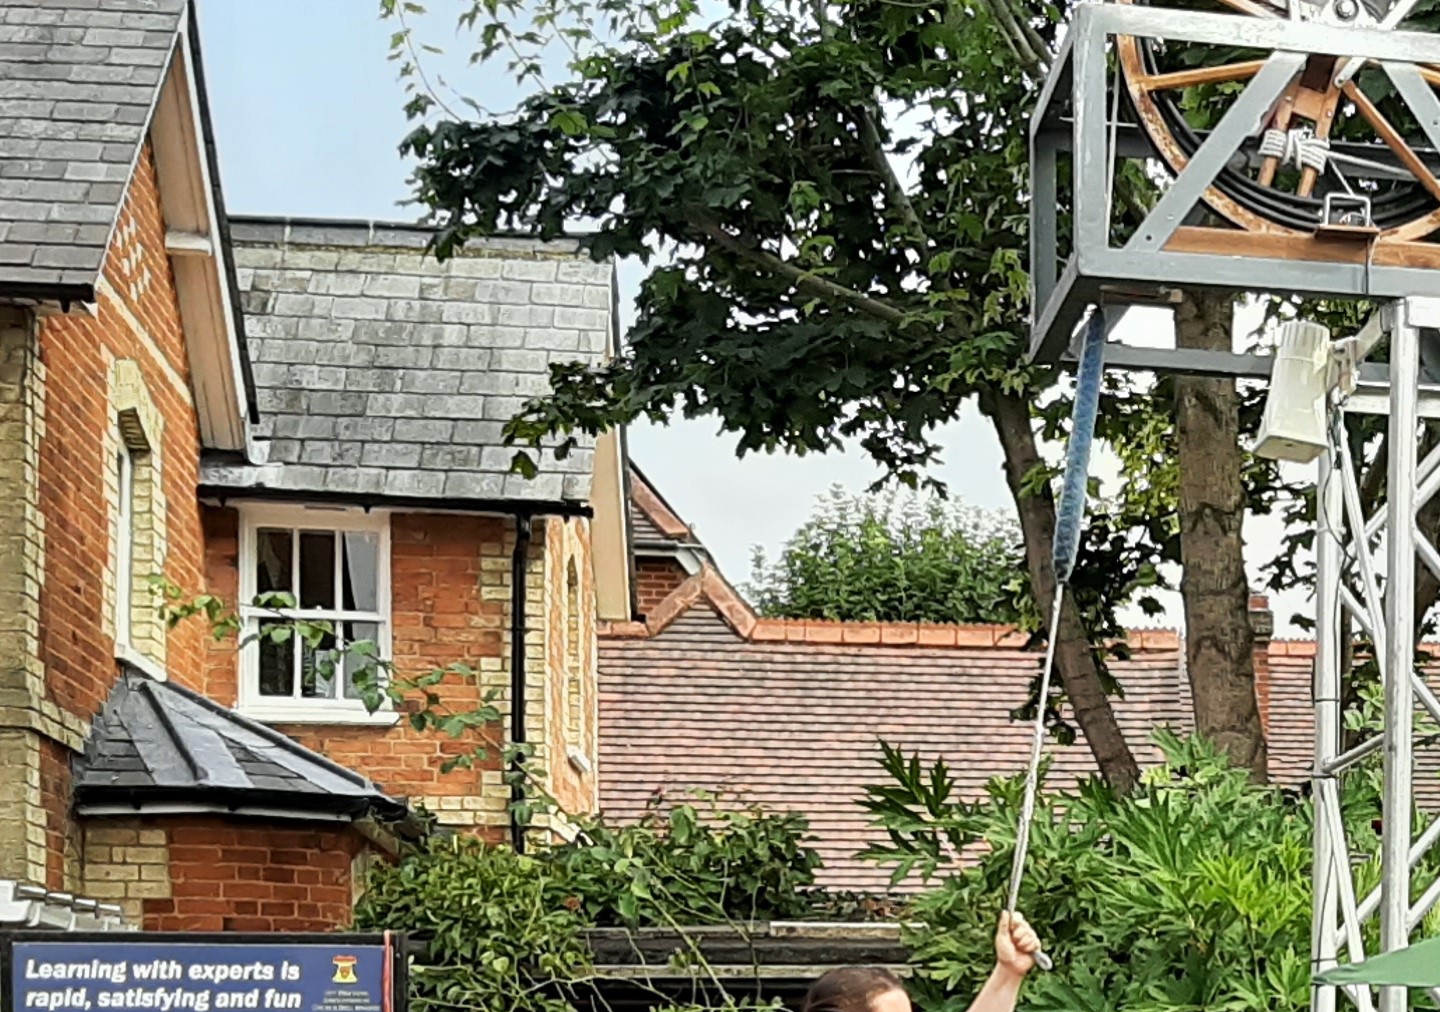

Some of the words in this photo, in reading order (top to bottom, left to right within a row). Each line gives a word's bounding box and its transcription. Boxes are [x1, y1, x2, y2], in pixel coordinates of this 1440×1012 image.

[25, 959, 127, 983] Learning
[132, 960, 182, 979] with
[188, 962, 273, 983] experts
[281, 961, 300, 980] is
[25, 987, 91, 1010] rapid,
[97, 987, 210, 1011] satisfying
[215, 988, 259, 1008] and
[264, 989, 302, 1008] fun
